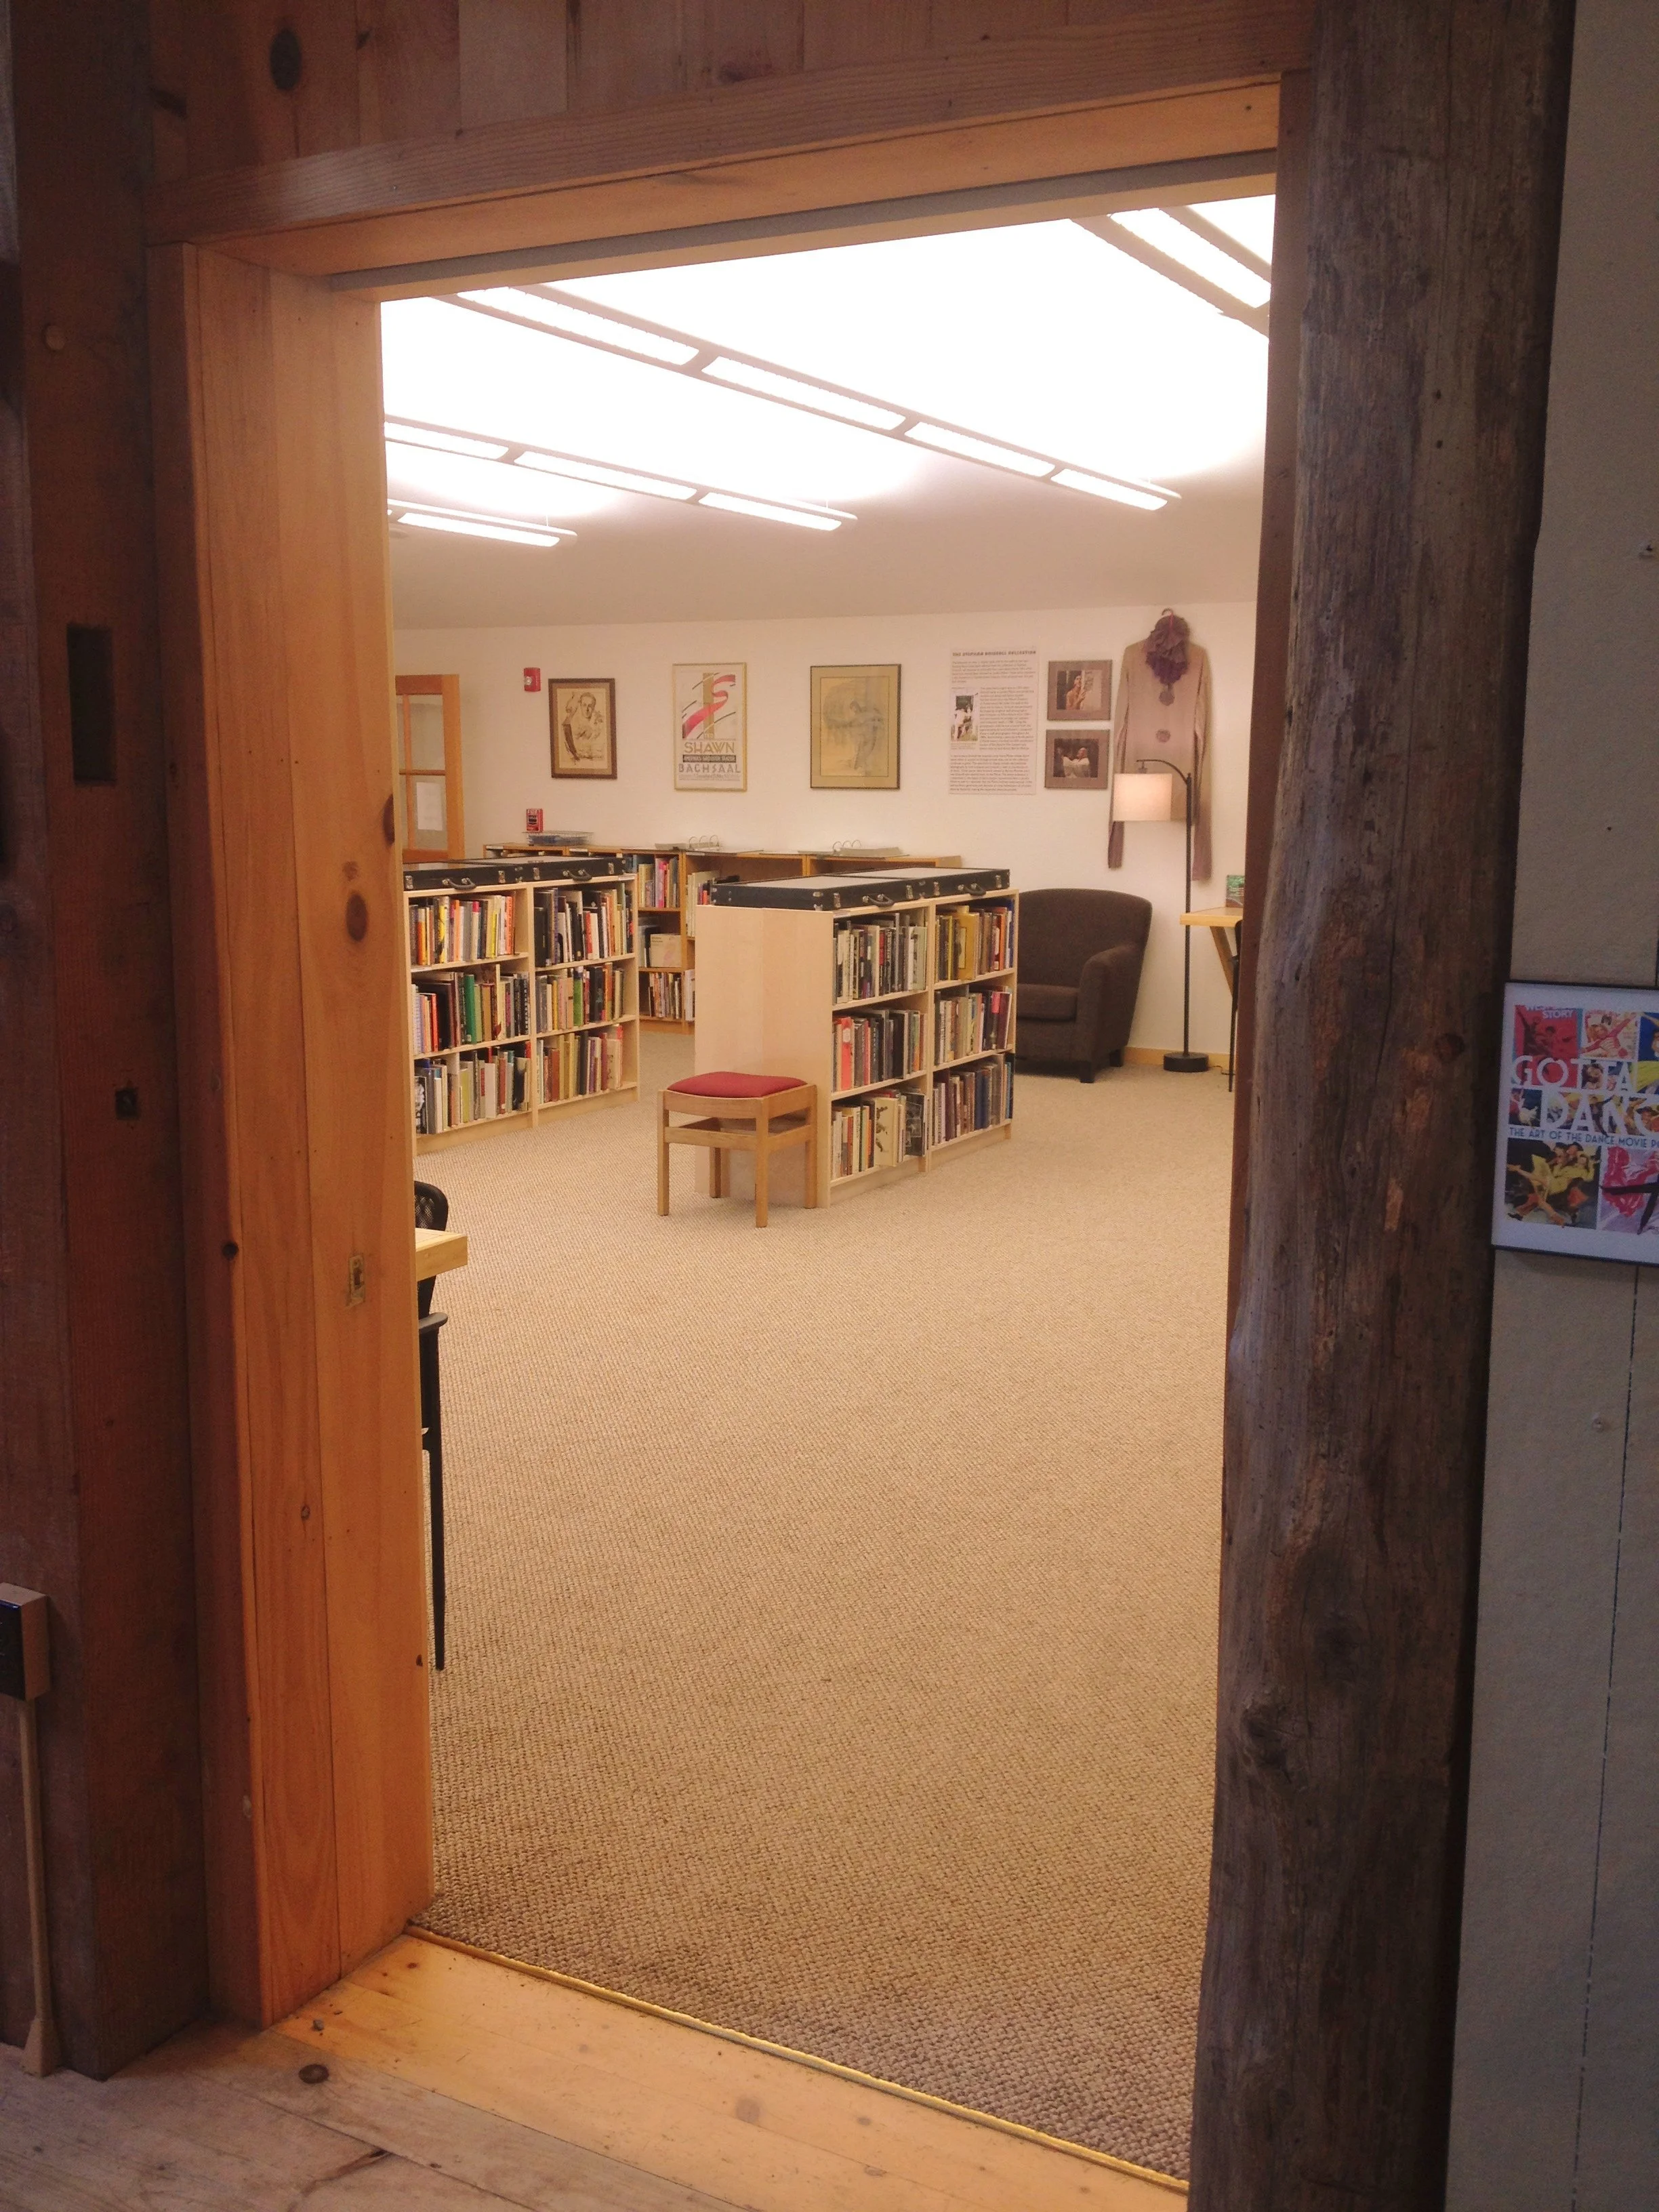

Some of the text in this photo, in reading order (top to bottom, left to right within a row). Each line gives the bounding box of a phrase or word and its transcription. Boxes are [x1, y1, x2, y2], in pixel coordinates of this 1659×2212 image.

[684, 741, 735, 754] SHAWN
[678, 763, 741, 773] BACHSAAL
[1542, 1010, 1574, 1019] STORY
[1513, 1055, 1632, 1092] GOTTA
[1509, 1127, 1524, 1137] THE
[1529, 1129, 1545, 1139] ART
[1549, 1130, 1561, 1140] OF
[1566, 1132, 1582, 1142] THE
[1586, 1134, 1614, 1145] DANCE
[1618, 1137, 1647, 1148] MOVIE
